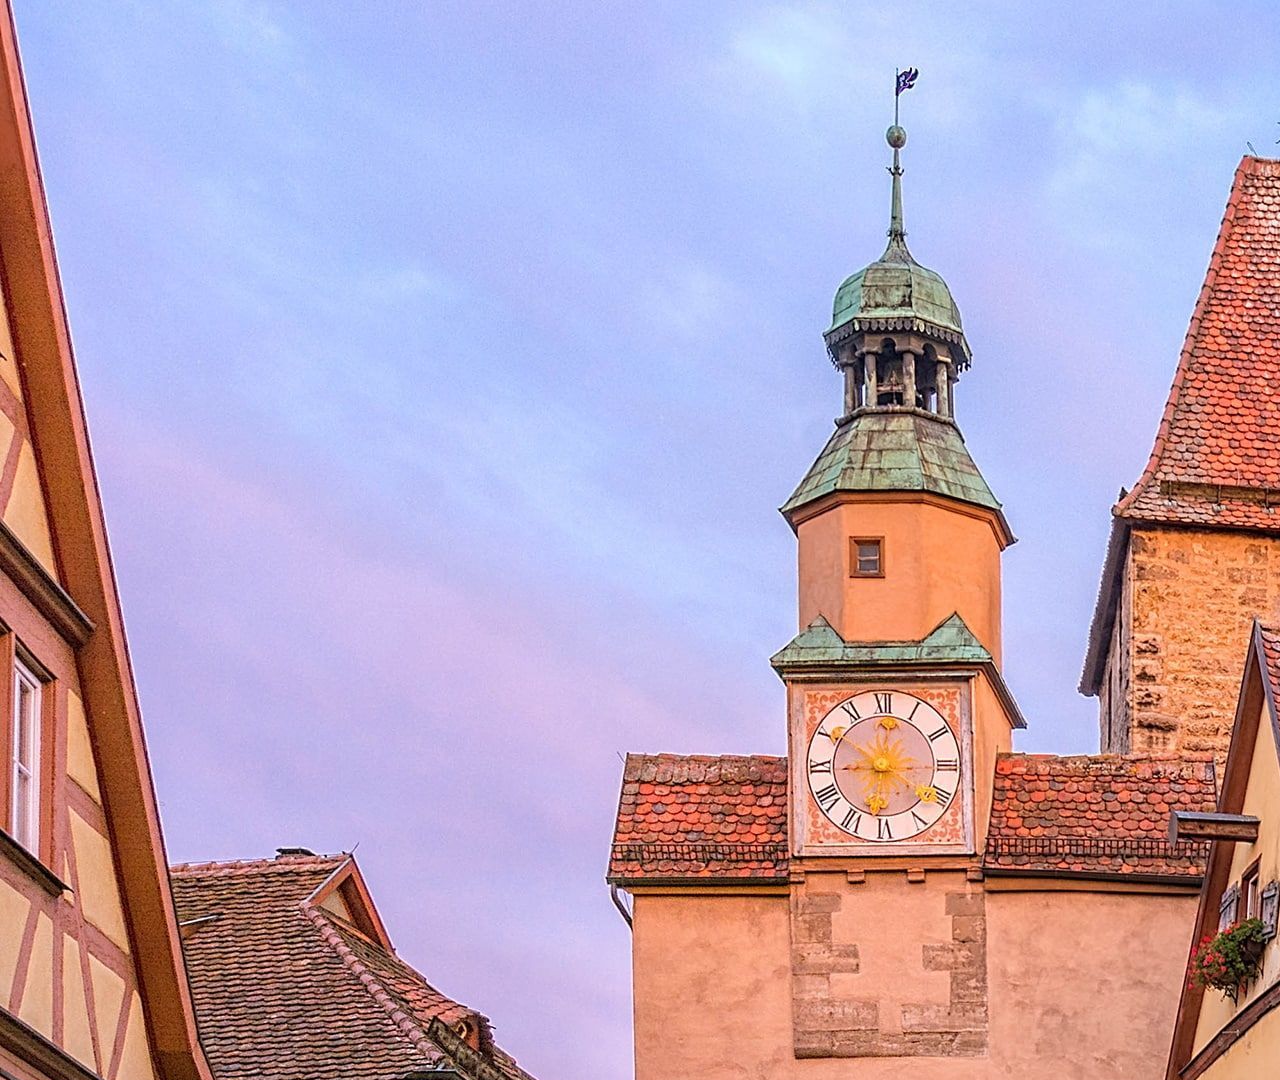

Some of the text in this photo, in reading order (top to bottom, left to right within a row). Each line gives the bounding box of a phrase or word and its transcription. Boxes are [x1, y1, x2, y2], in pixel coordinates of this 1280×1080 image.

[839, 701, 861, 724] XI
[873, 692, 893, 714] XII
[907, 701, 922, 722] I
[927, 725, 950, 743] II
[810, 759, 831, 775] IX
[936, 759, 958, 773] III
[815, 783, 842, 814] VIII
[840, 807, 862, 835] VII
[876, 818, 894, 840] VI
[911, 810, 929, 832] V
